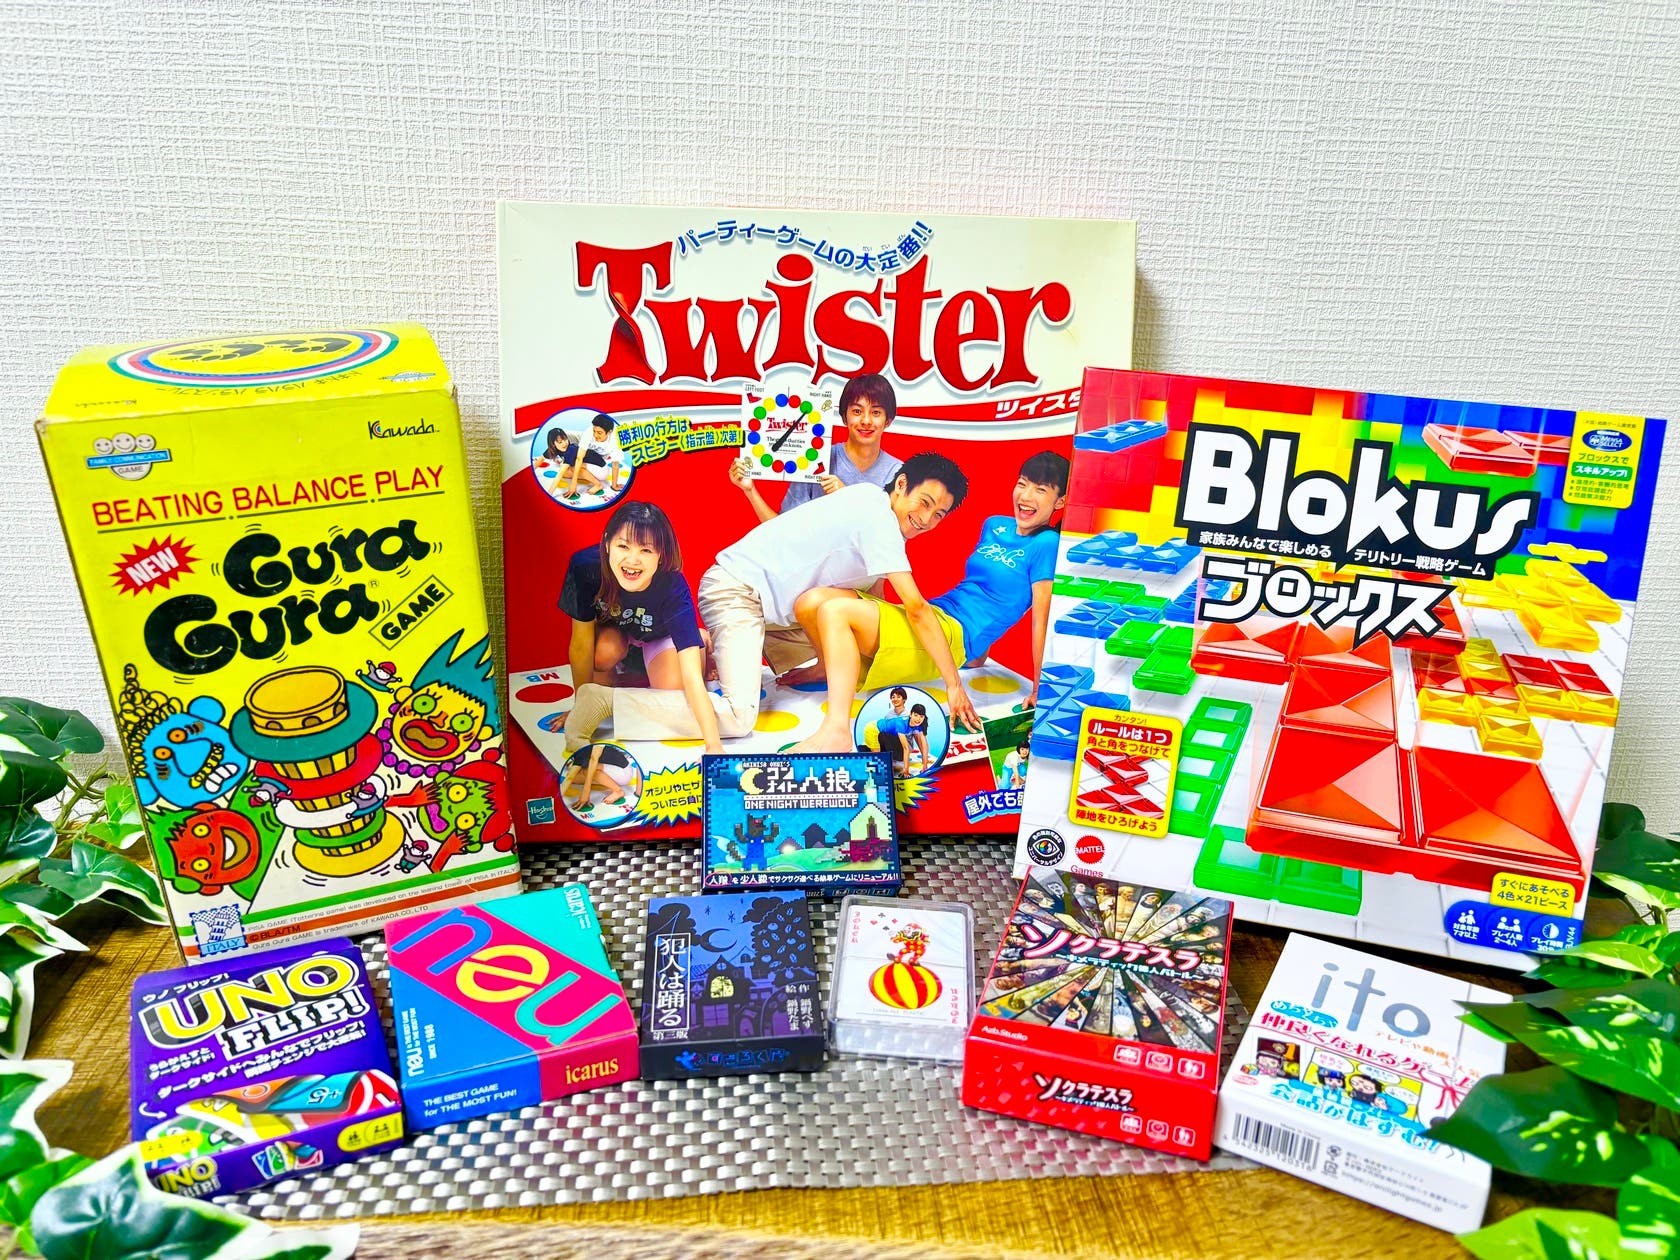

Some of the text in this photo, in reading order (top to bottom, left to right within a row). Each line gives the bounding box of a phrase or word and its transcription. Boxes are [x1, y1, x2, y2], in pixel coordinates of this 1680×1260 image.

[575, 240, 1072, 388] Twister
[368, 418, 437, 441] Kawada
[618, 419, 688, 446] 勝利の行方は
[92, 466, 443, 525] BEATING BALANCE PLAY
[1183, 431, 1530, 555] Blokus
[125, 546, 180, 586] NEW
[222, 520, 431, 599] Gura
[1199, 530, 1486, 576] 家族みんなで楽しめる テリトリー戦略ゲーム
[381, 584, 445, 641] GAME
[1203, 561, 1449, 640] ブロックス
[143, 584, 379, 675] Gura
[1093, 722, 1168, 743] ルールは1つ
[1114, 714, 1147, 725] カンタン!
[1087, 736, 1171, 758] 角と角をつなげて
[800, 766, 856, 792] 人狼
[745, 799, 858, 810] ONE NIGHT WEREWOLF
[1075, 809, 1157, 832] 陣地をひろげよう
[1075, 845, 1105, 854] MATTEL
[1071, 865, 1104, 878] Games
[1497, 891, 1568, 910] 4色×21ピース
[1500, 879, 1570, 898] すぐにあそべる
[292, 932, 313, 942] GAME
[323, 921, 359, 935] trademark
[370, 912, 400, 924] KAWADA
[1491, 930, 1524, 941] プレイ人数
[205, 939, 241, 953] ITALY
[1020, 925, 1201, 971] ソクラテスラ
[391, 907, 623, 1047] neu
[656, 938, 687, 1027] 犯人は踊る
[142, 988, 171, 1004] ウノ
[147, 956, 357, 1043] UNO
[1311, 962, 1431, 1038] ito
[228, 990, 367, 1053] FLIP!
[652, 1030, 689, 1041] 第三版
[406, 1047, 425, 1077] neu
[565, 1058, 619, 1085] icarus
[424, 1083, 499, 1107] THE BEST GAME
[425, 1089, 517, 1117] for THE MOST FUN!
[1033, 1074, 1133, 1105] ソクラテスラ
